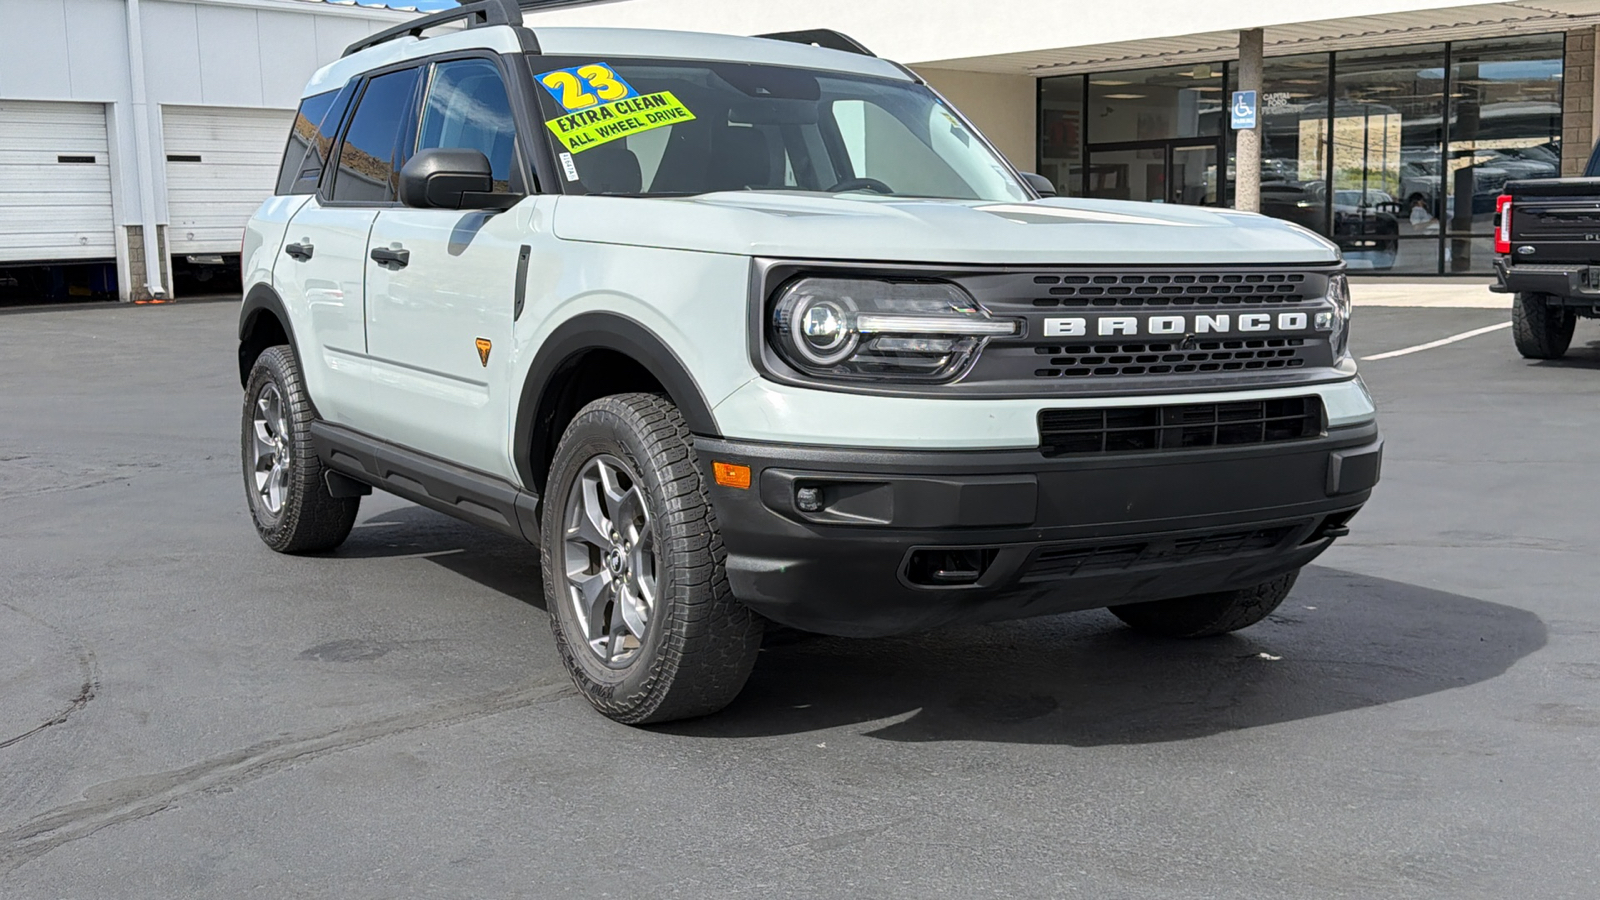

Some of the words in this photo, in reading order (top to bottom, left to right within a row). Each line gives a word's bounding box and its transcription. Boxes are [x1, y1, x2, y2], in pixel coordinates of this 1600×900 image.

[542, 65, 628, 109] 23
[1262, 92, 1290, 101] CAPITAL
[556, 106, 614, 133] EXTRA
[614, 94, 667, 115] CLEAN
[568, 132, 595, 149] ALL
[595, 117, 645, 138] WHEEL
[645, 107, 686, 124] DRIVE
[1044, 312, 1308, 336] BRONCO
